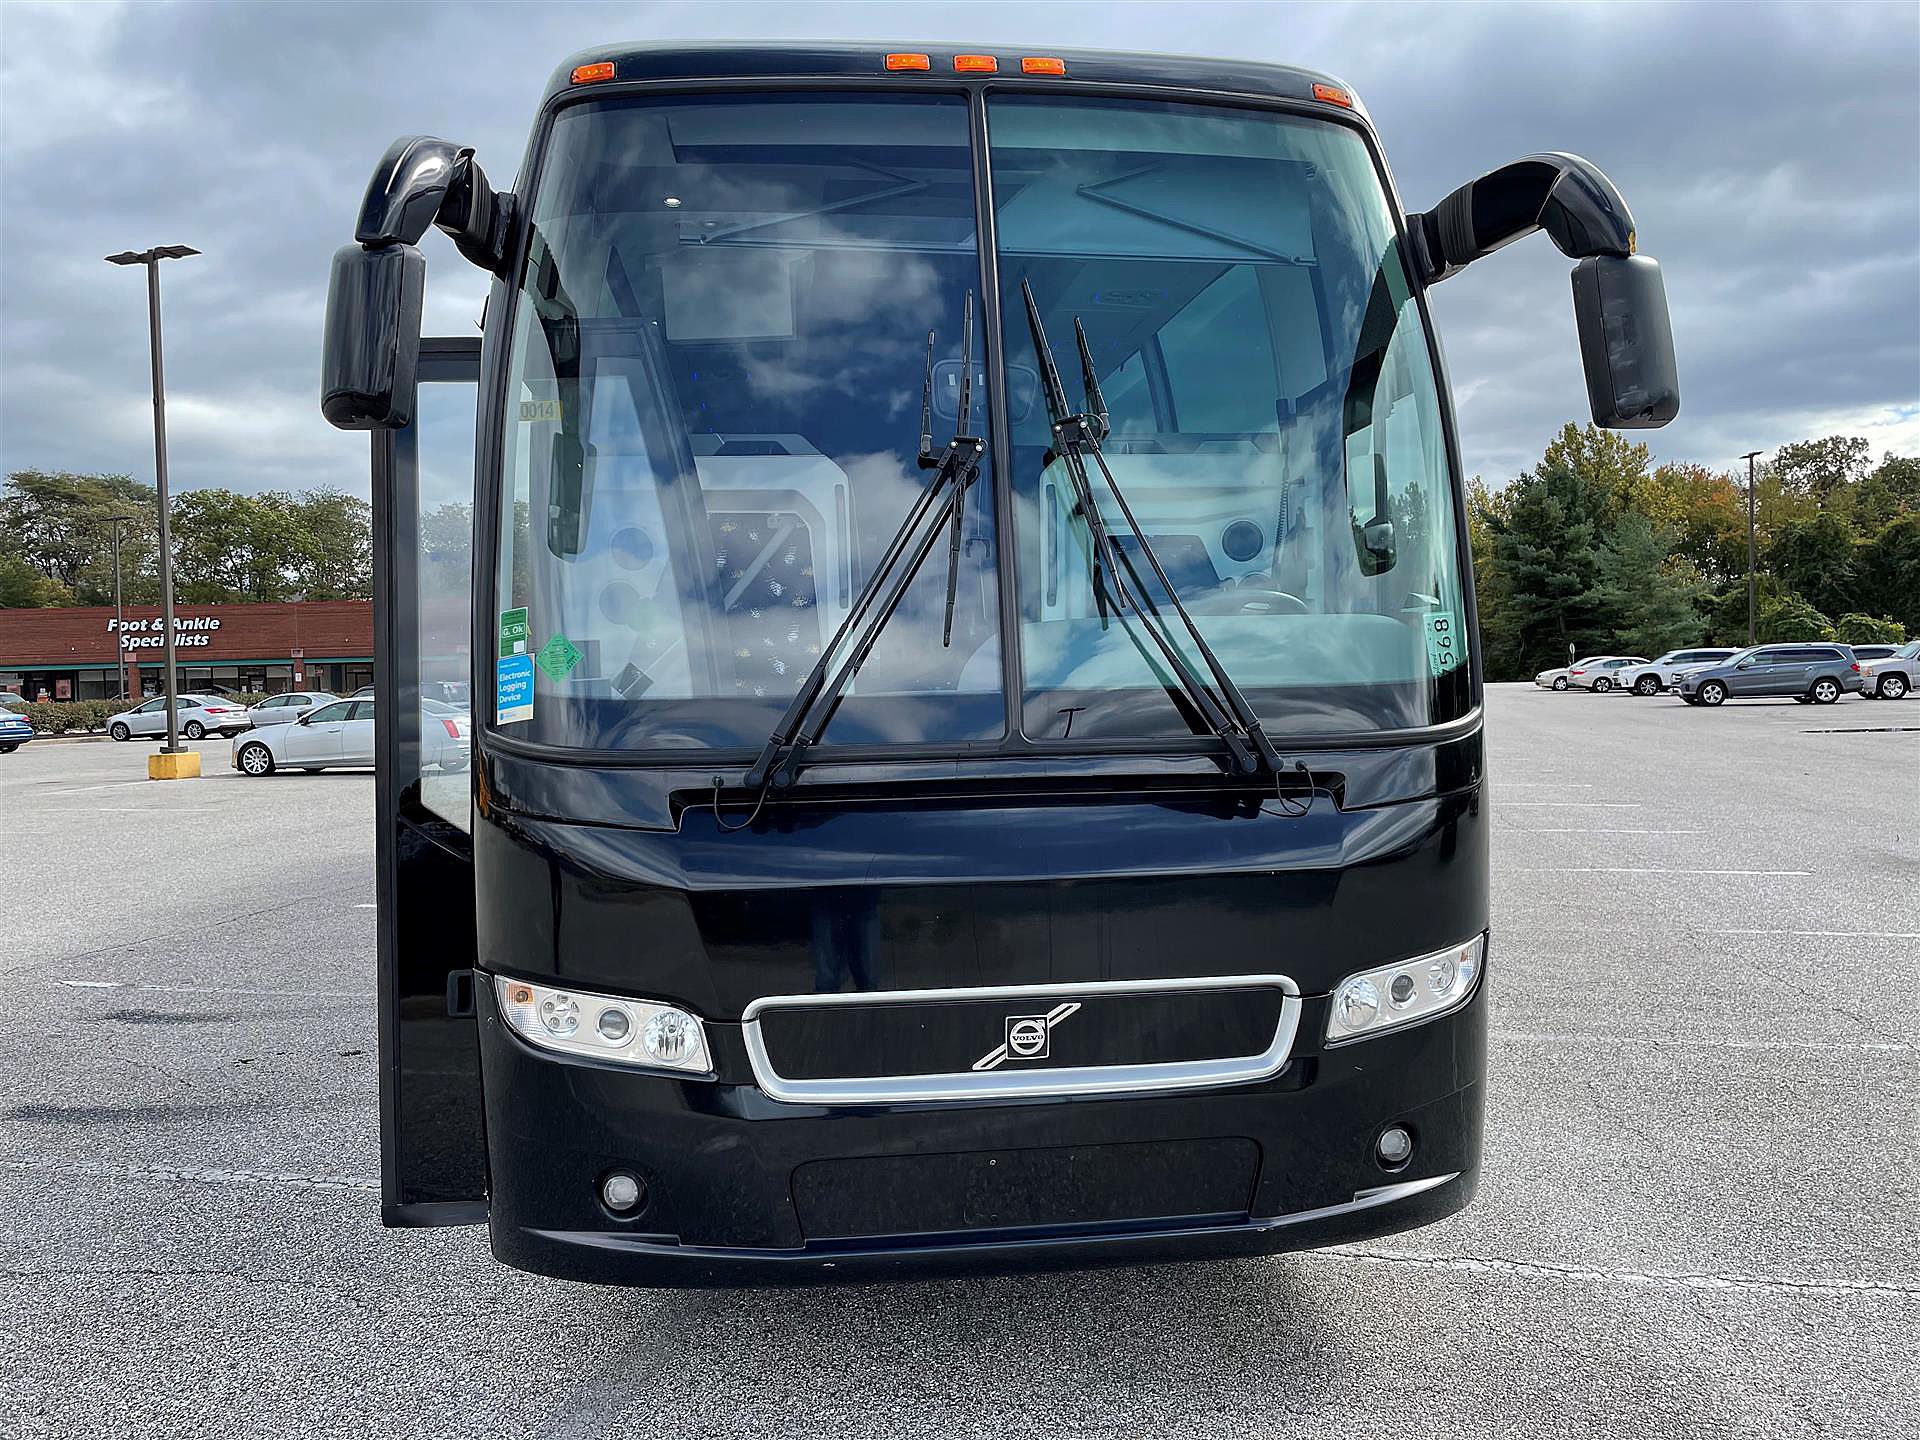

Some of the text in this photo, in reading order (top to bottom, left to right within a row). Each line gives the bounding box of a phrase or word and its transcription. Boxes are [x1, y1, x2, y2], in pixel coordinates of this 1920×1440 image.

[107, 617, 221, 632] Foot & Ankle
[121, 633, 210, 651] Specilists
[499, 669, 532, 681] Electronic
[499, 681, 527, 692] Logging
[499, 693, 522, 703] Device
